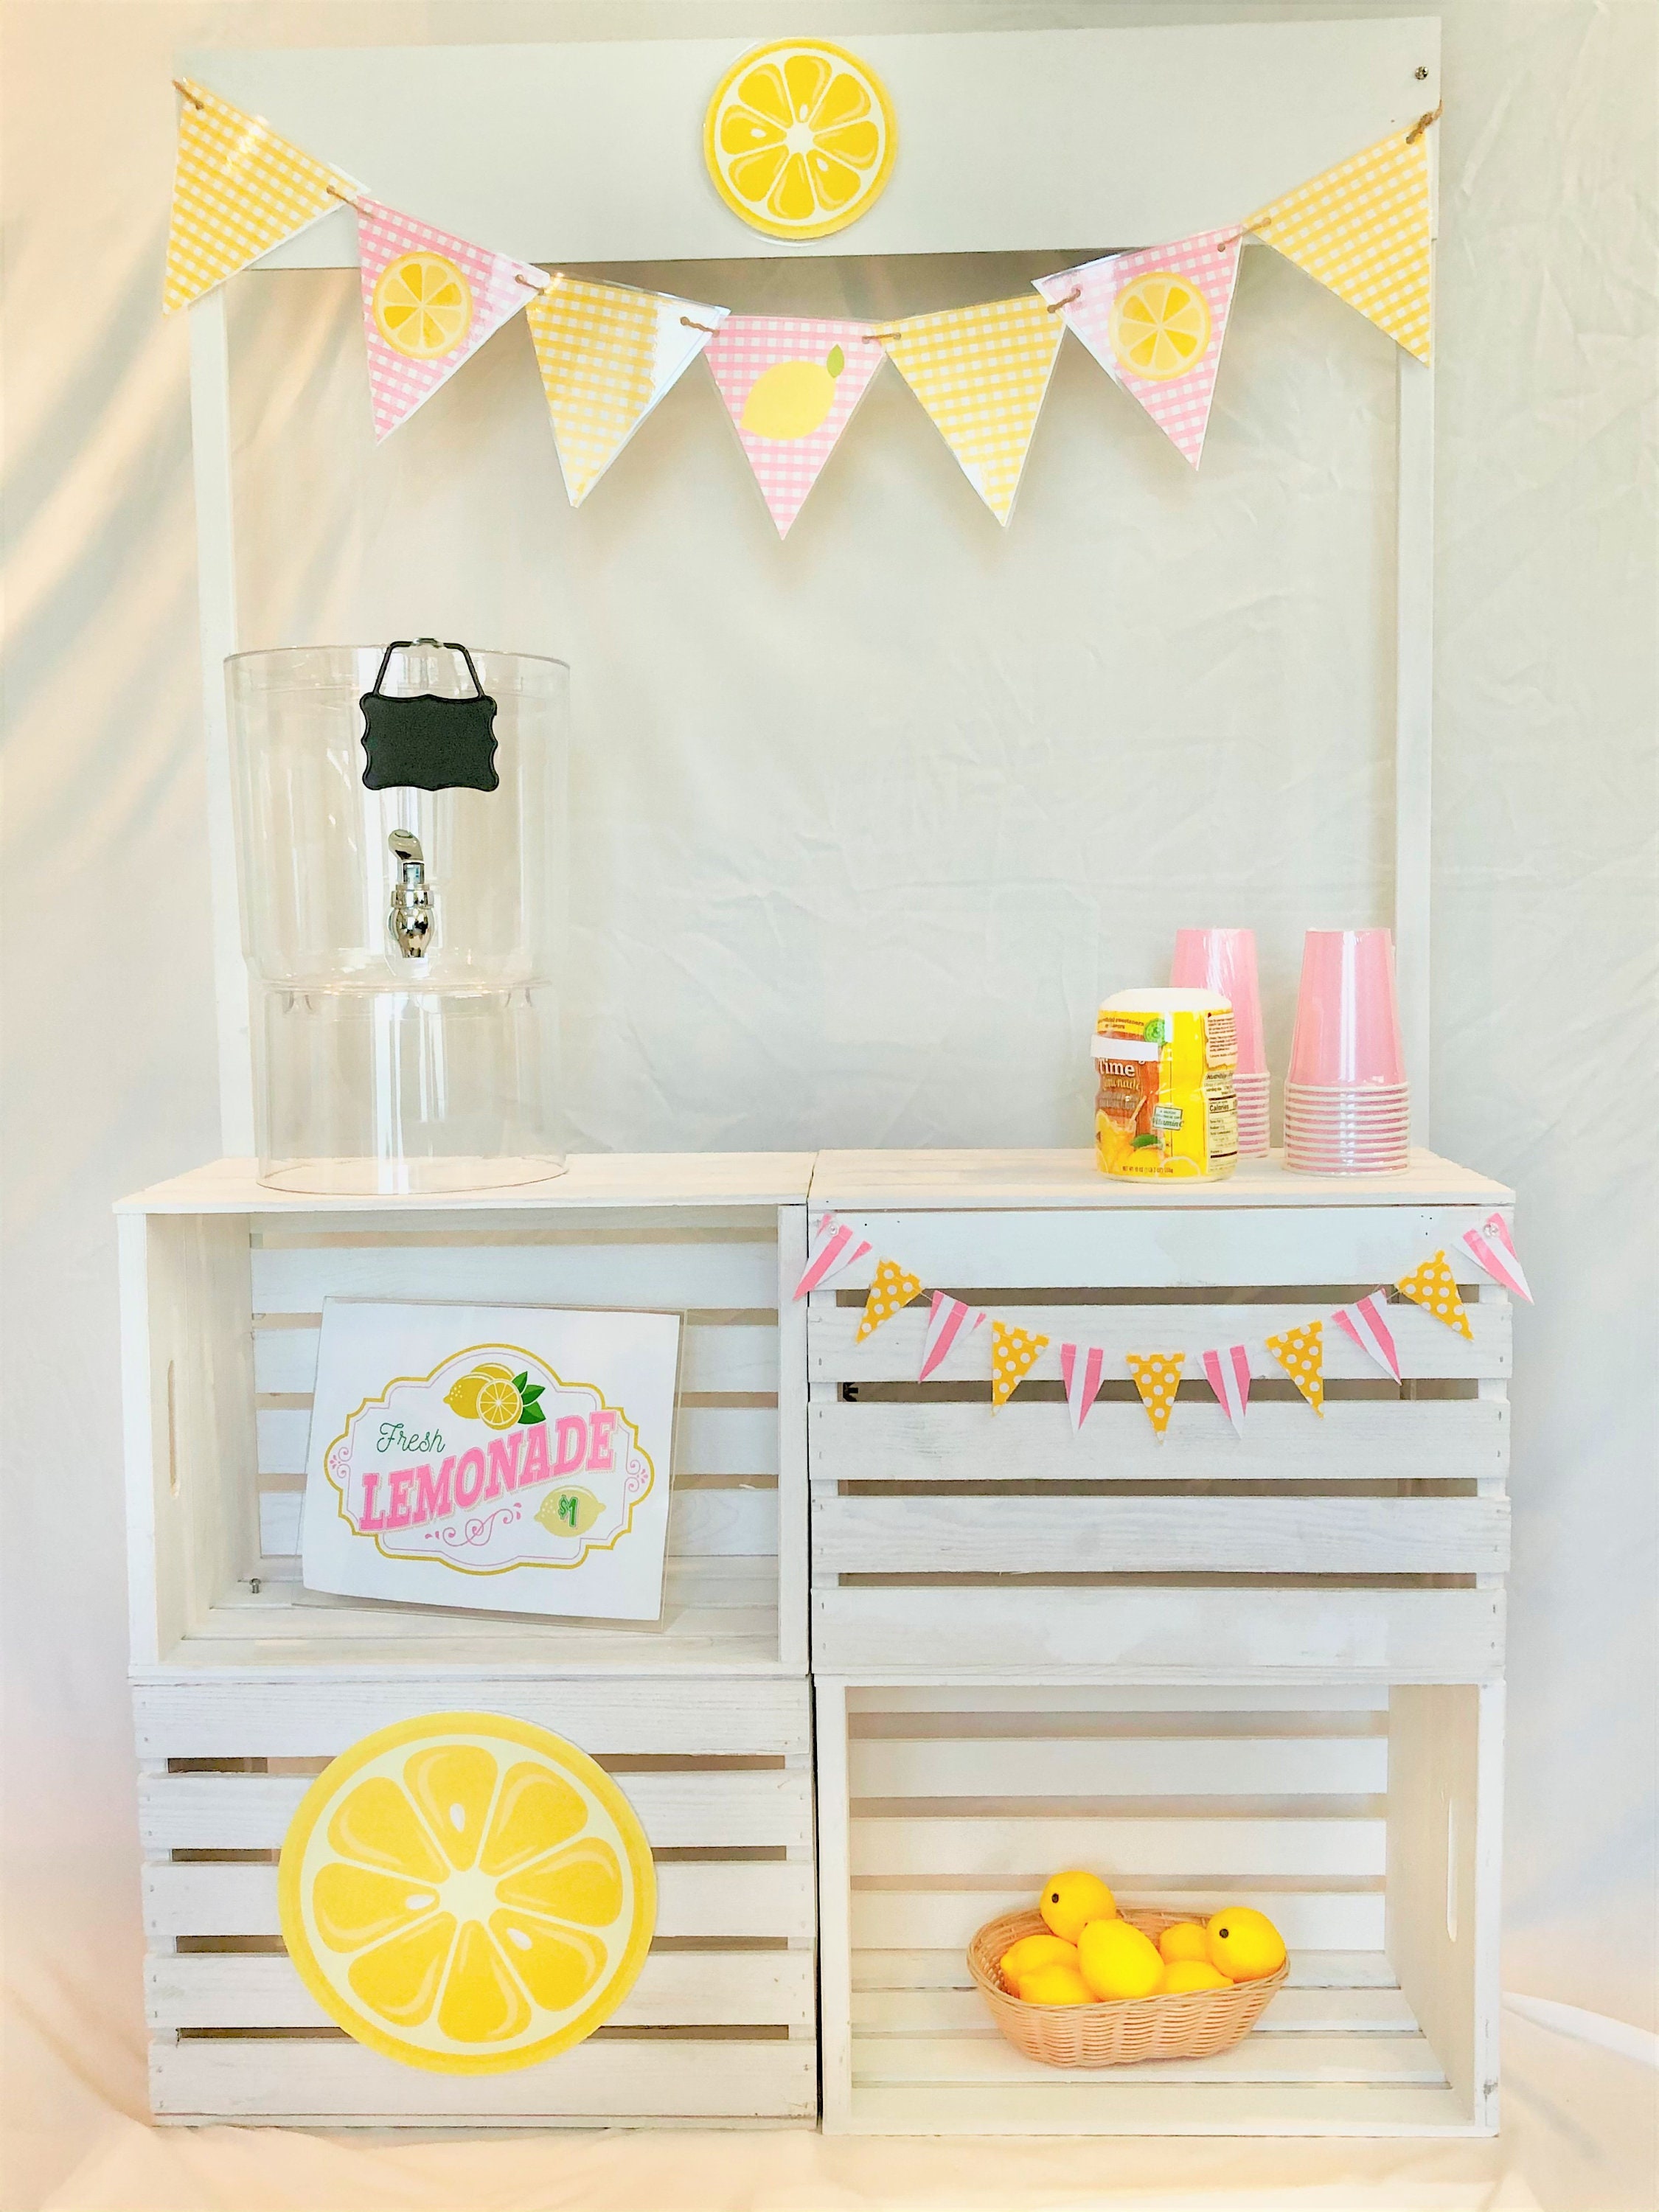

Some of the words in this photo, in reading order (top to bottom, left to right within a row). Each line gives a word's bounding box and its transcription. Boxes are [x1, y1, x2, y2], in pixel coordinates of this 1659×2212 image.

[376, 1422, 445, 1453] Fresh
[358, 1411, 617, 1532] LEMONADE
[557, 1494, 579, 1528] $1
